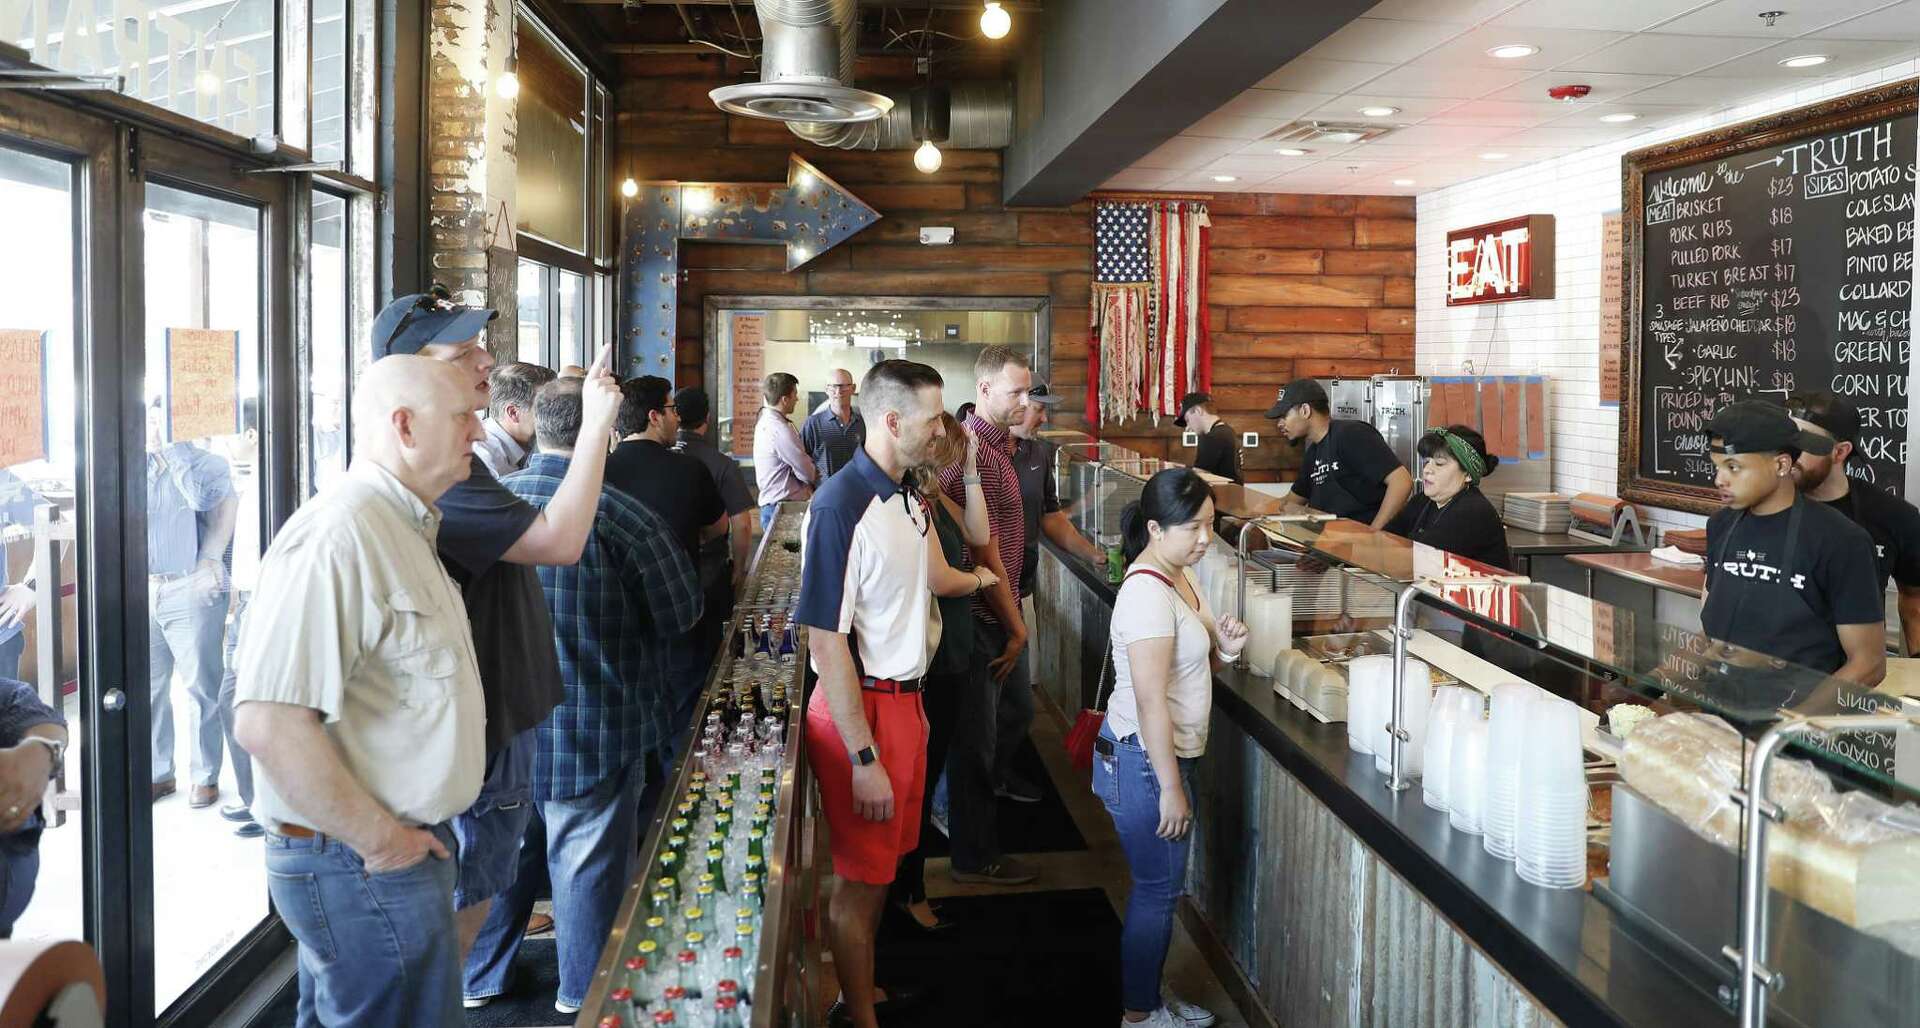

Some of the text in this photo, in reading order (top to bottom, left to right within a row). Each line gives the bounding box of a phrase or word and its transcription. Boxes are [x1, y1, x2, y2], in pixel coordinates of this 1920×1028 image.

[1782, 122, 1892, 175] TRUTH
[1807, 172, 1844, 194] SIDES
[1850, 164, 1901, 195] POTATO
[1677, 176, 1794, 219] BRISKET $23
[1649, 202, 1672, 221] MEAT
[1670, 207, 1793, 243] PORK RIBS $18
[1846, 224, 1893, 249] BAKED
[1450, 226, 1529, 300] EAT
[1671, 238, 1792, 266] PULLED PORK $17
[1670, 264, 1795, 288] TURKEY BREAST $17
[1847, 254, 1888, 276] PINTO
[1673, 286, 1800, 313] BEEF RIB $23
[1840, 280, 1912, 300] COLLARD
[1656, 304, 1664, 318] 3
[1838, 310, 1871, 331] MAC
[1876, 310, 1887, 328] &
[1773, 314, 1796, 337] $18
[1654, 332, 1677, 343] TYPES
[1697, 338, 1796, 362] GARLIC $18
[1835, 341, 1892, 363] GREEN
[1686, 365, 1795, 392] SPICY LINK $18
[1831, 374, 1880, 396] CORN
[1661, 391, 1702, 410] PRICED
[1668, 410, 1703, 432] POUND
[1885, 408, 1908, 429] TO
[1714, 560, 1806, 590] RUTH
